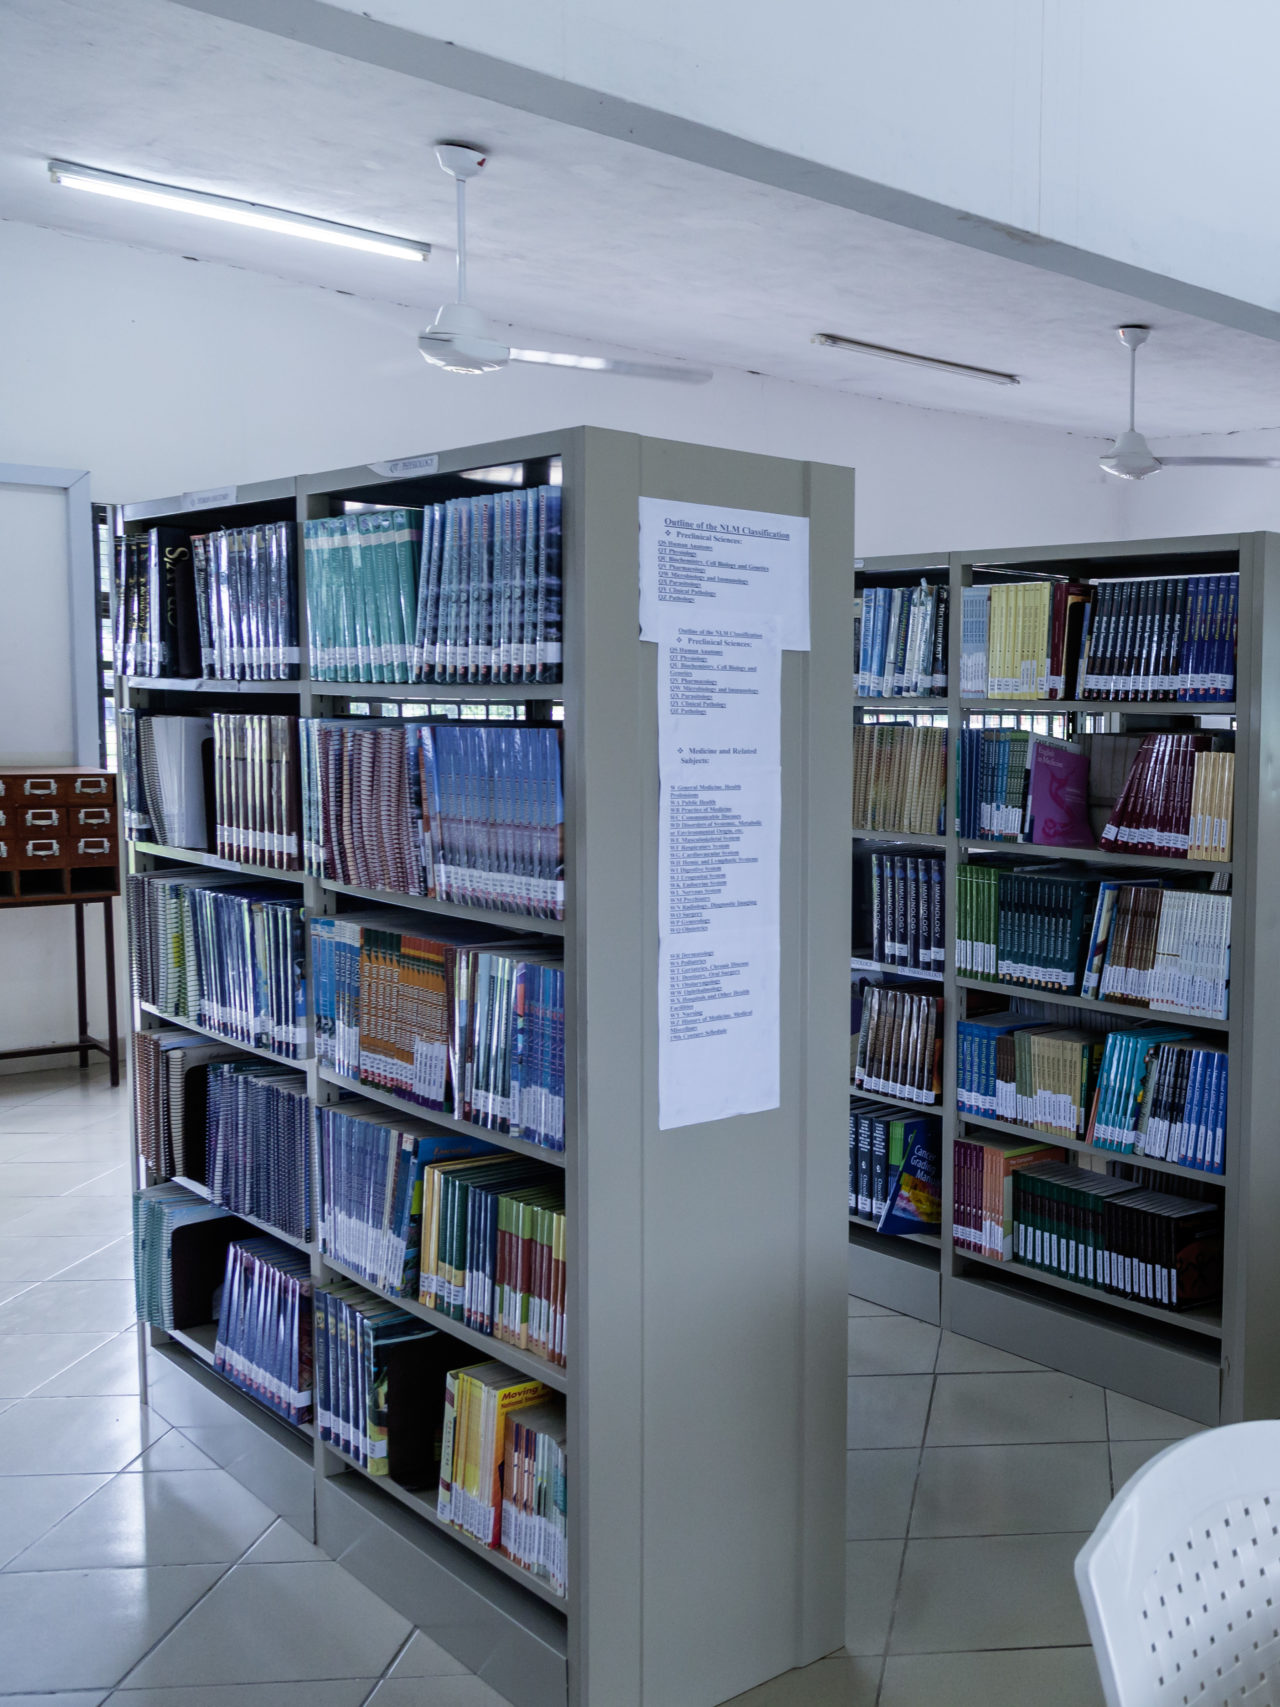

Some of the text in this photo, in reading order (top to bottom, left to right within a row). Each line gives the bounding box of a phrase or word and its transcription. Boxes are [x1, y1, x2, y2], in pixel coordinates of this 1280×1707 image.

[664, 517, 694, 529] Outline
[706, 523, 717, 531] the
[720, 524, 739, 533] NLM
[742, 527, 790, 539] Classification
[677, 532, 743, 544] Preclinical Sciences:
[688, 638, 722, 646] Preclinical
[363, 963, 371, 976] Core
[361, 978, 370, 1005] Concepts
[369, 980, 378, 1007] Concepts
[376, 981, 385, 1008] Concepts
[390, 984, 399, 1012] Concepts
[362, 1015, 370, 1036] Health
[369, 1017, 378, 1038] Health
[390, 1022, 398, 1043] Health
[501, 1386, 538, 1402] Moving
